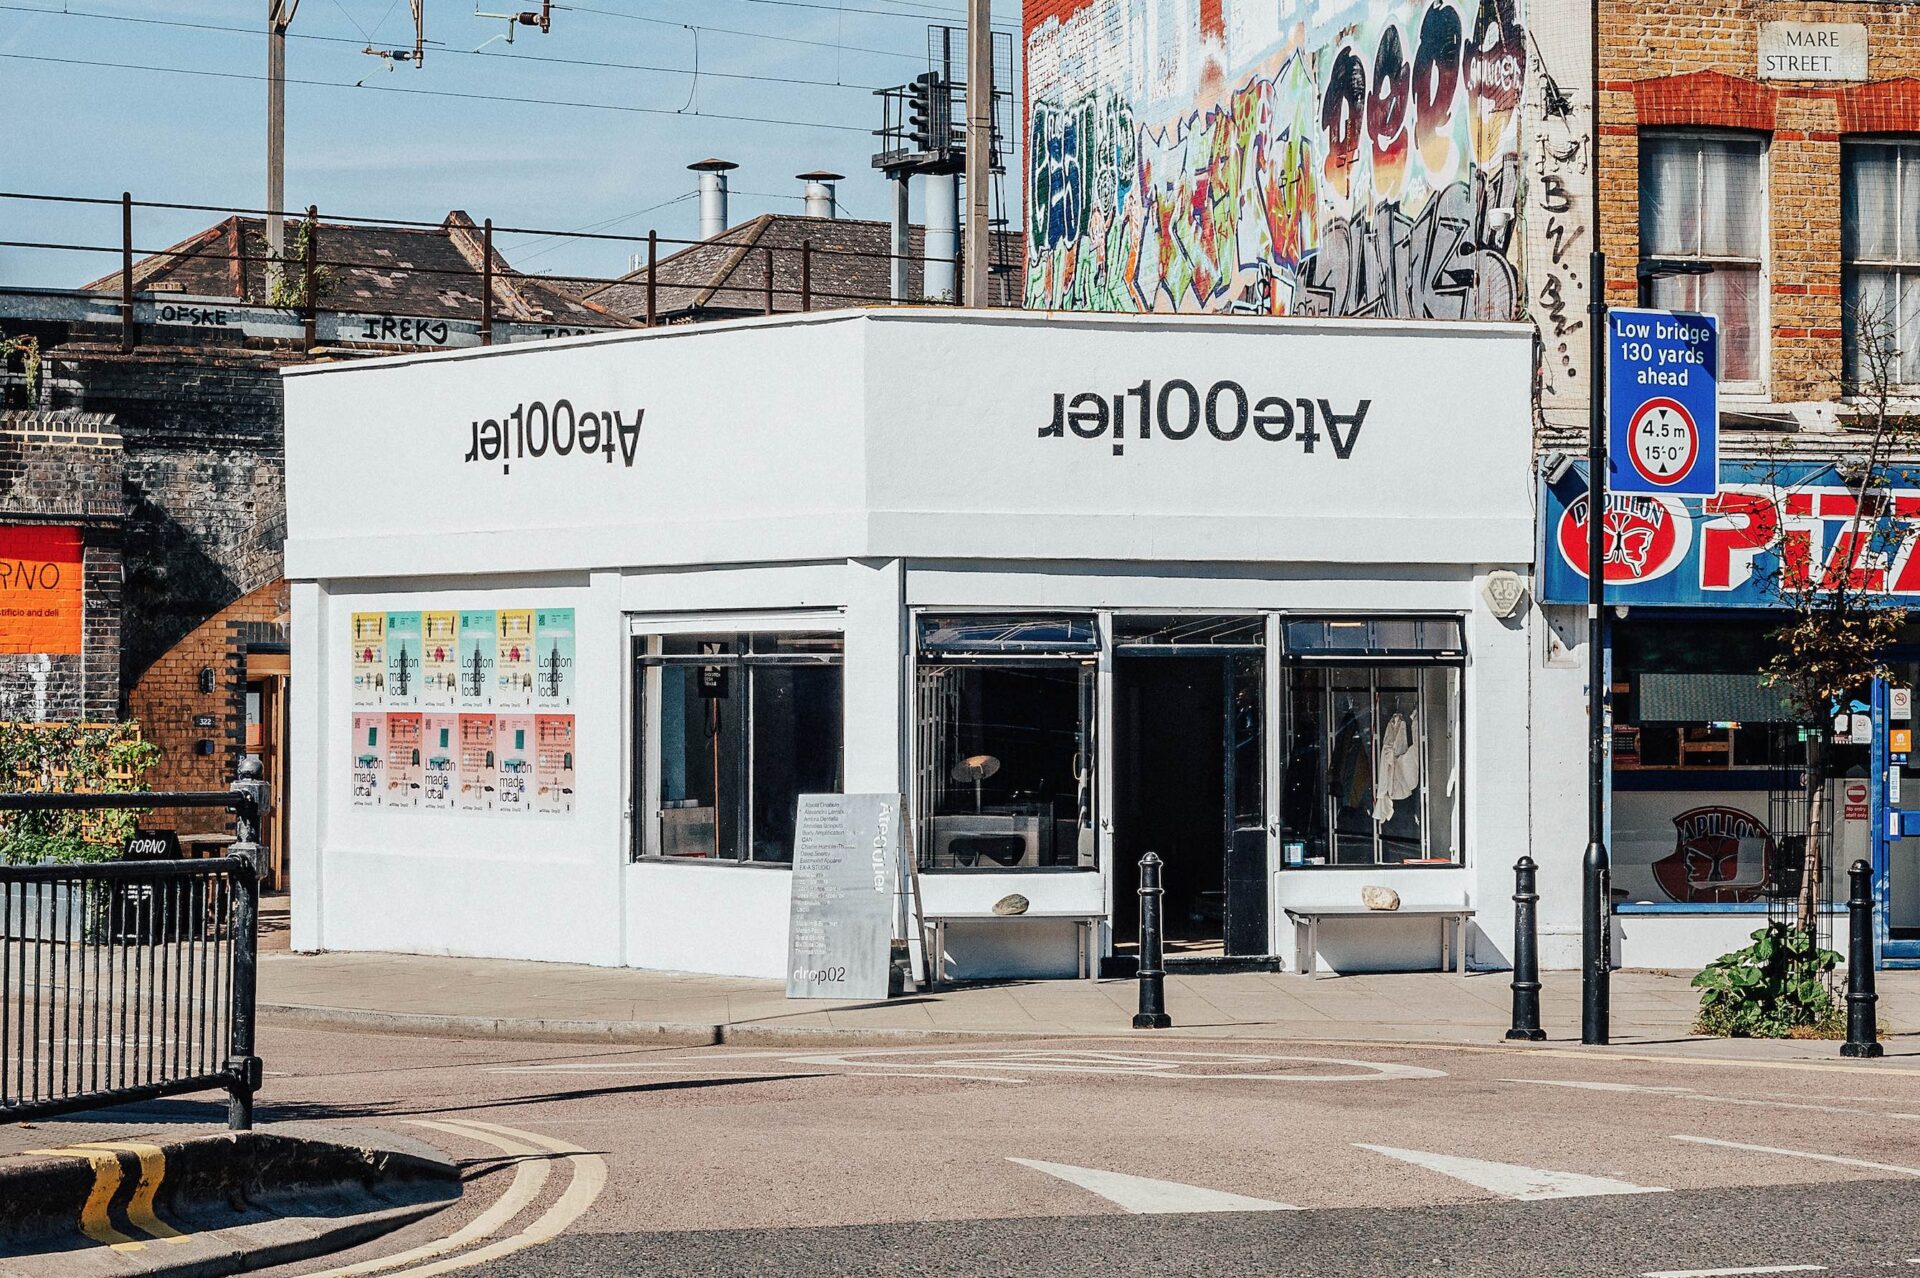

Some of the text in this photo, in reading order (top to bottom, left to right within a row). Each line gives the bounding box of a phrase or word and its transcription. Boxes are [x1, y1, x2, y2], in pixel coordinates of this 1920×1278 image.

[1786, 31, 1840, 47] MARE
[1617, 319, 1710, 344] Low bridge
[1621, 342, 1704, 365] 130 yards
[1637, 367, 1688, 386] ahead
[1642, 420, 1685, 438] 4.5 m
[1573, 493, 1664, 530] PPILLON
[27, 609, 43, 617] and
[44, 609, 59, 617] deli
[389, 655, 419, 668] London
[461, 655, 494, 668] London
[538, 654, 572, 668] London
[389, 670, 412, 682] made
[461, 670, 487, 683] made
[538, 669, 564, 683] made
[389, 683, 407, 696] local
[461, 683, 482, 697] local
[538, 683, 559, 697] local
[199, 718, 212, 726] 322
[354, 756, 383, 769] London
[425, 758, 456, 771] London
[499, 759, 532, 774] London
[353, 771, 377, 784] made
[425, 772, 449, 786] made
[499, 775, 525, 789] made
[353, 784, 372, 797] local
[425, 786, 444, 799] local
[499, 788, 520, 802] local
[129, 839, 166, 854] FORNO
[793, 965, 846, 986] drop02
